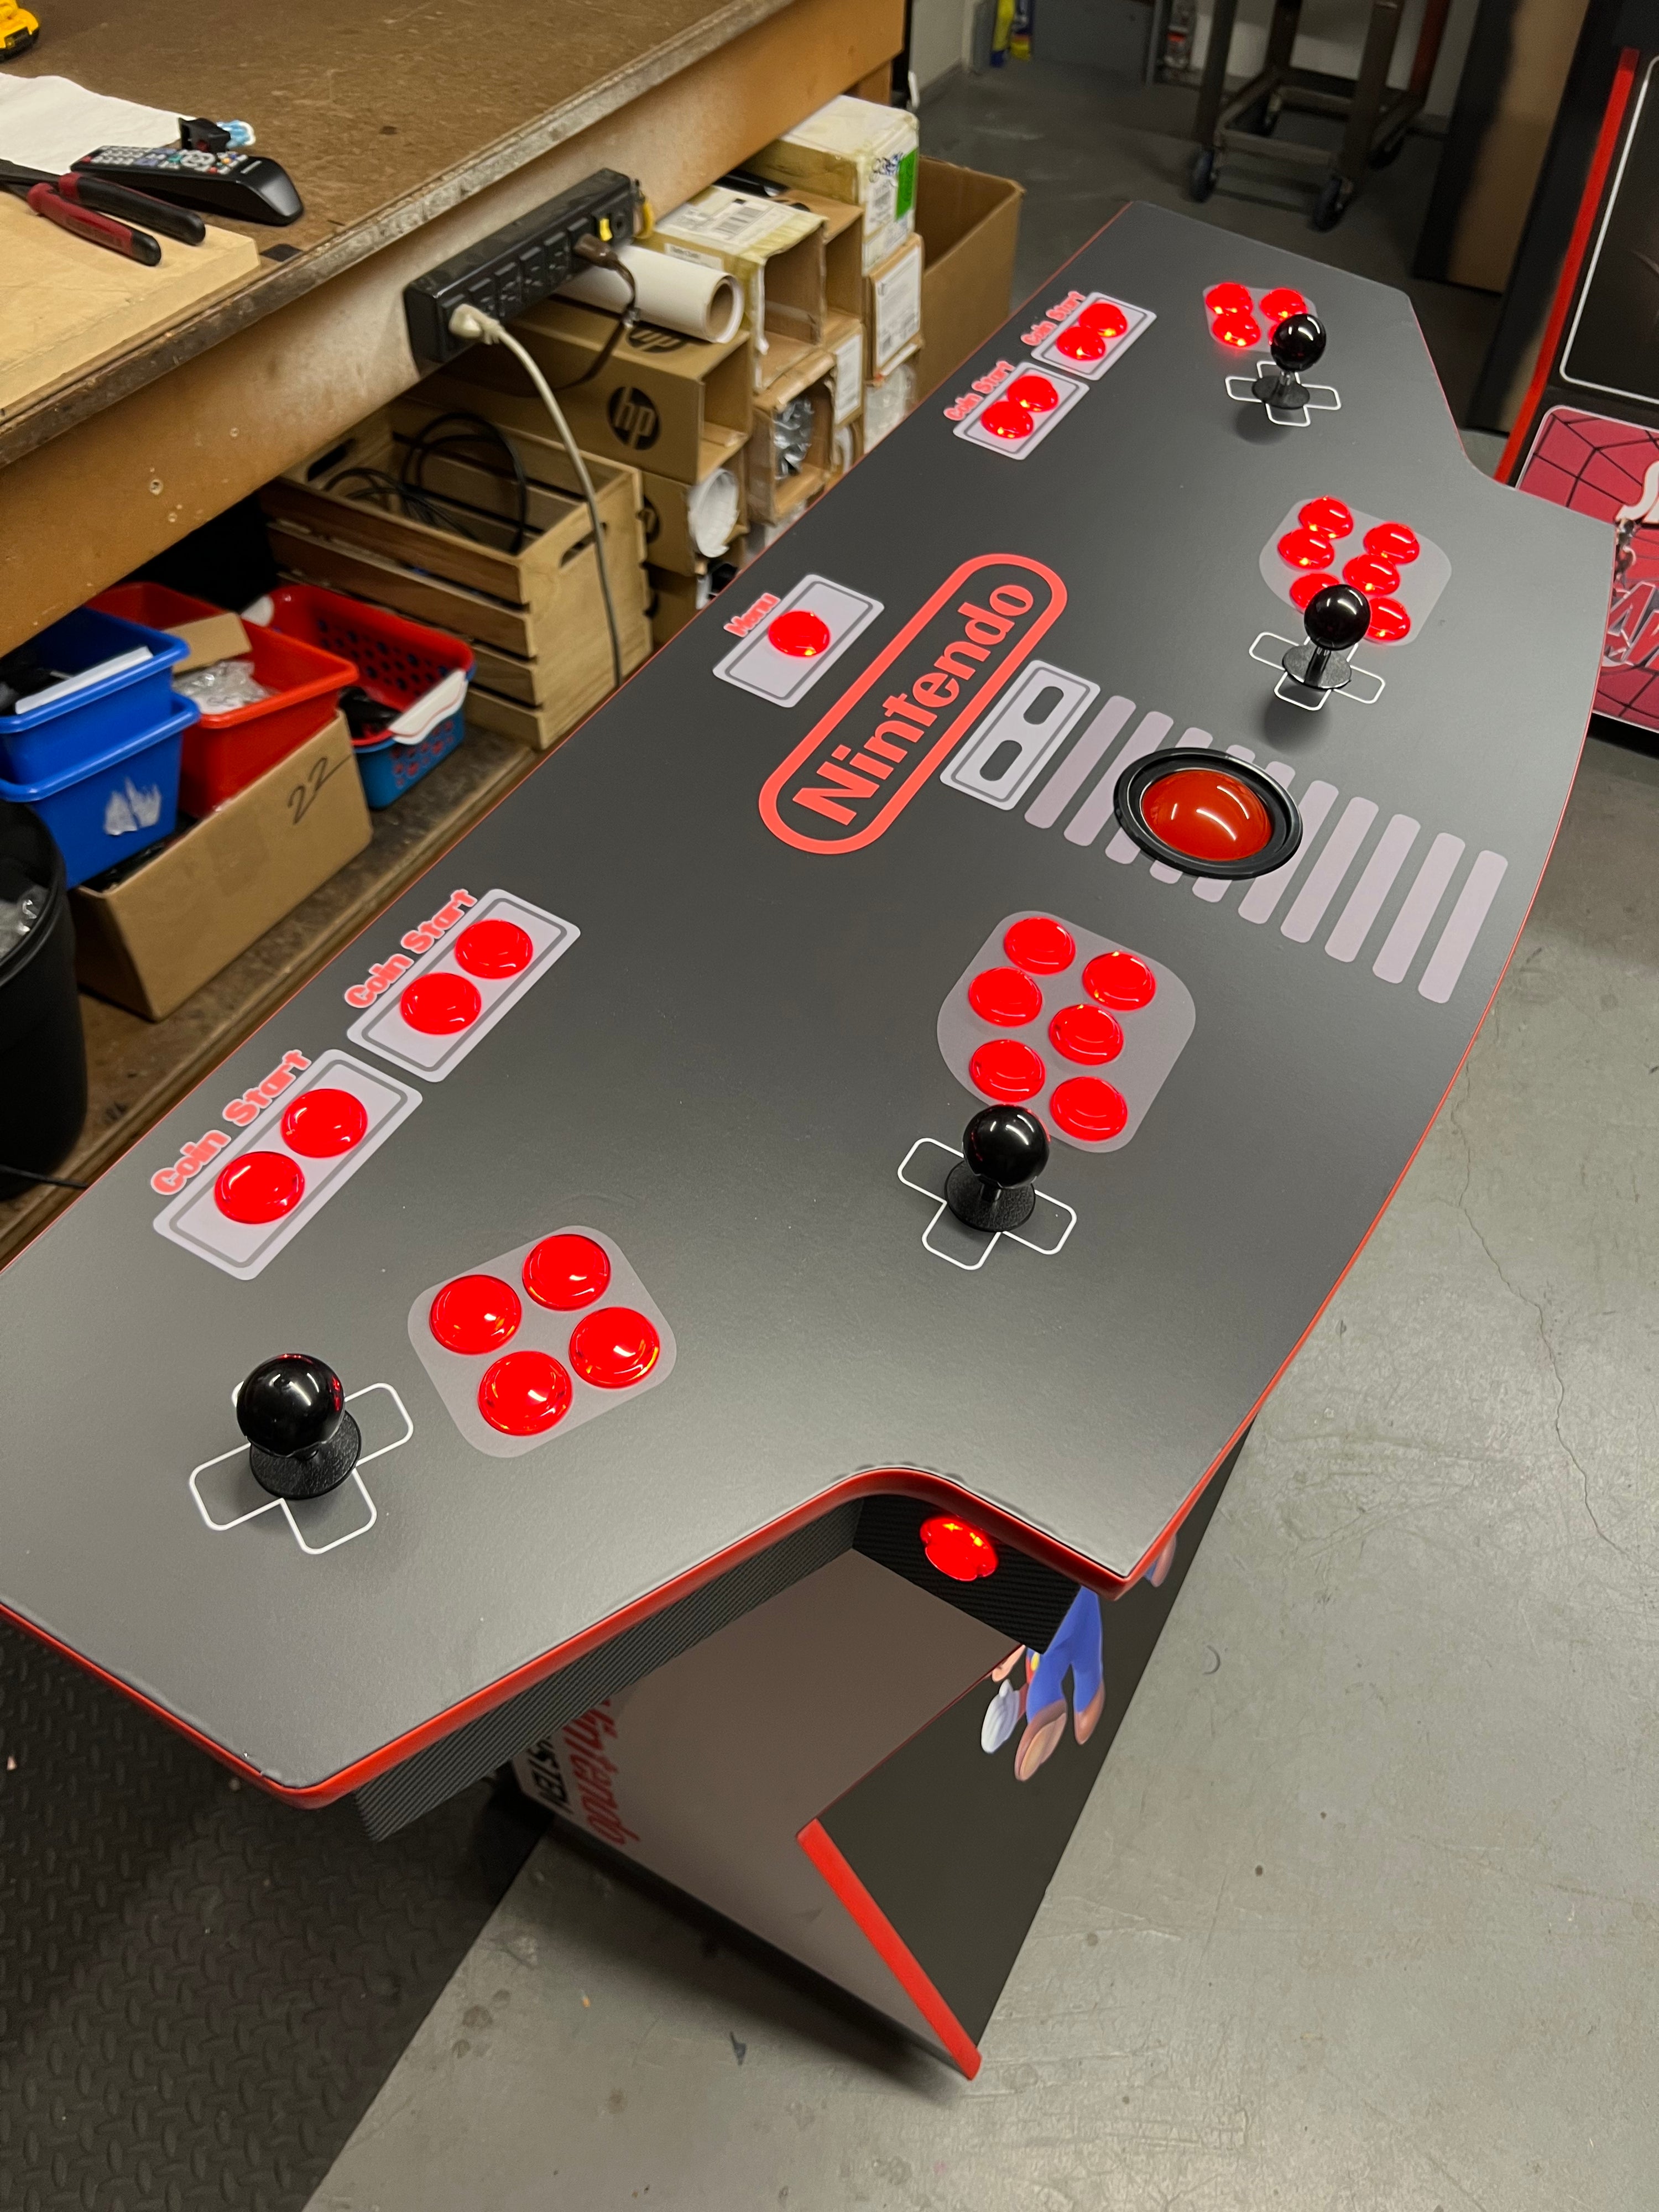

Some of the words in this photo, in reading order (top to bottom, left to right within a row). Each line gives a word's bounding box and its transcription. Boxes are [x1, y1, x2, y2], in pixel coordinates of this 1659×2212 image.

[1020, 321, 1057, 346] Coin
[1046, 290, 1086, 321] Start
[614, 387, 656, 450] hp
[943, 393, 984, 421] Coin
[971, 360, 1015, 394] Start
[723, 592, 781, 638] Menu
[792, 584, 1034, 826] Nintendo
[287, 755, 352, 825] 22
[344, 953, 414, 1008] Coin
[400, 888, 478, 954] Start
[150, 1129, 232, 1196] Coin
[222, 1049, 312, 1127] Start
